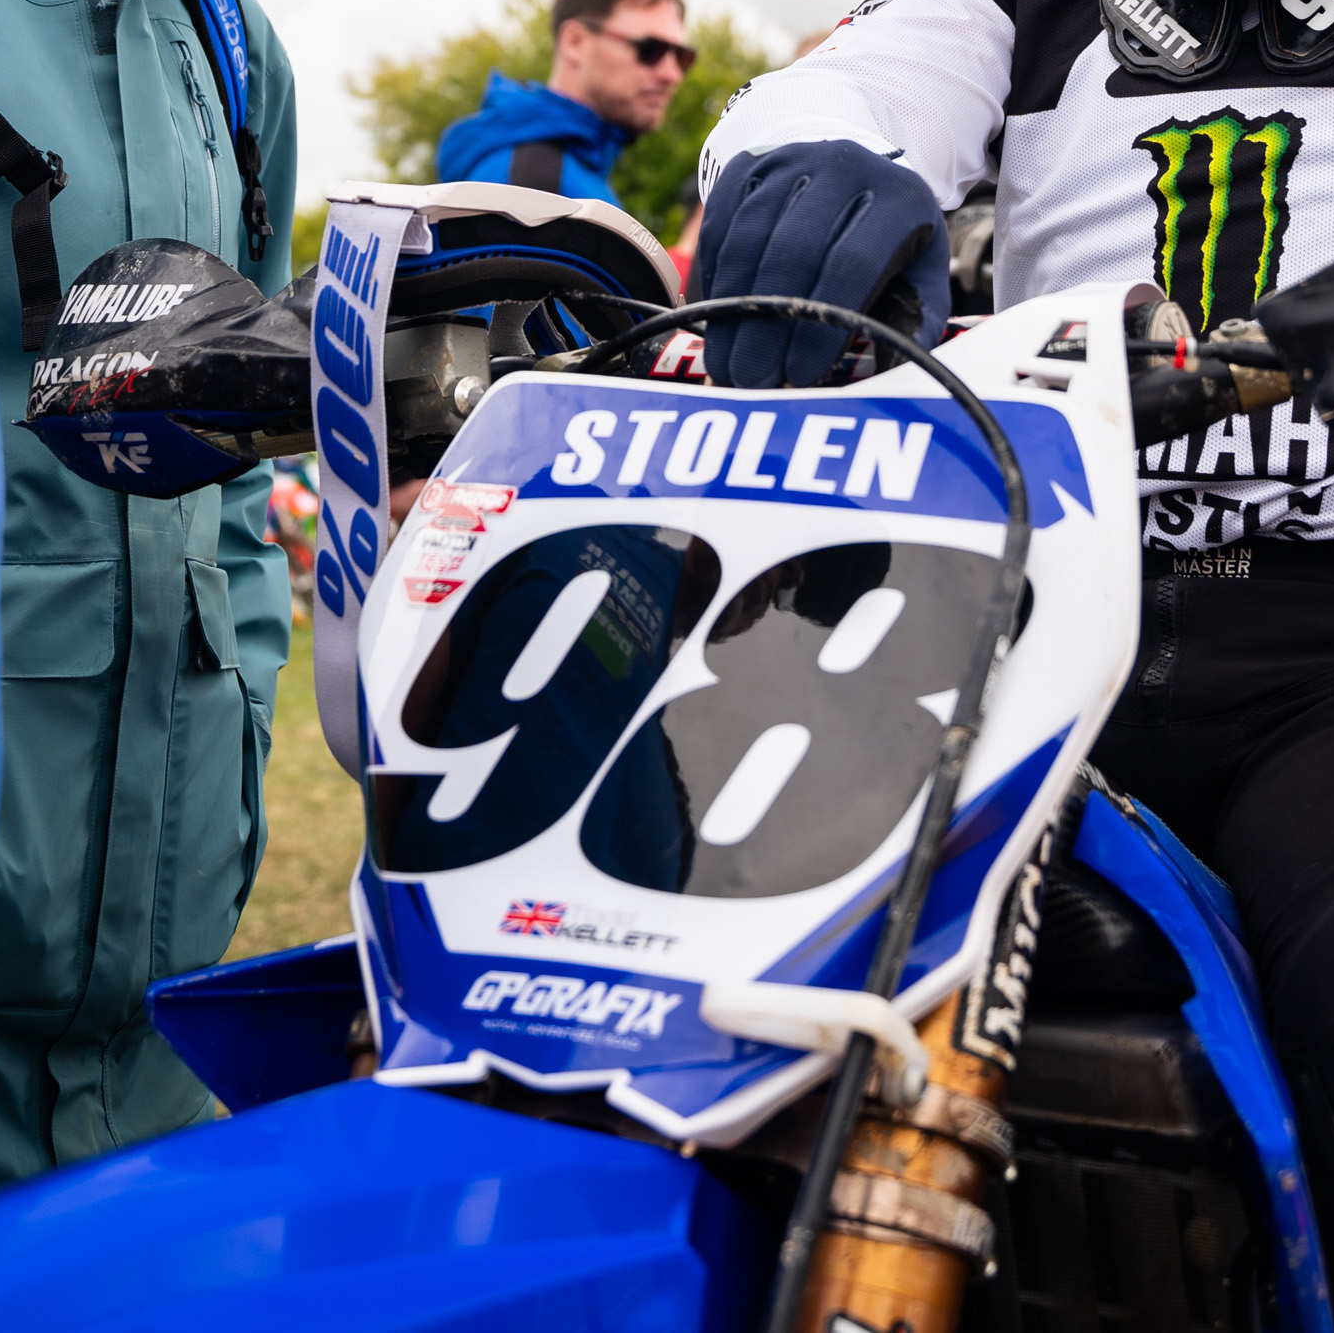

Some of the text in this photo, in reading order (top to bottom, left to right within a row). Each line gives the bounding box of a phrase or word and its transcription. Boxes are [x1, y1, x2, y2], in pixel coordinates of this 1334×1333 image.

[57, 283, 194, 326] YAMALUBE
[551, 409, 934, 502] STOLEN
[1173, 558, 1251, 575] MASTER
[368, 523, 1035, 900] 98
[556, 923, 680, 952] KELLETT
[462, 970, 684, 1039] GPGRAFIX
